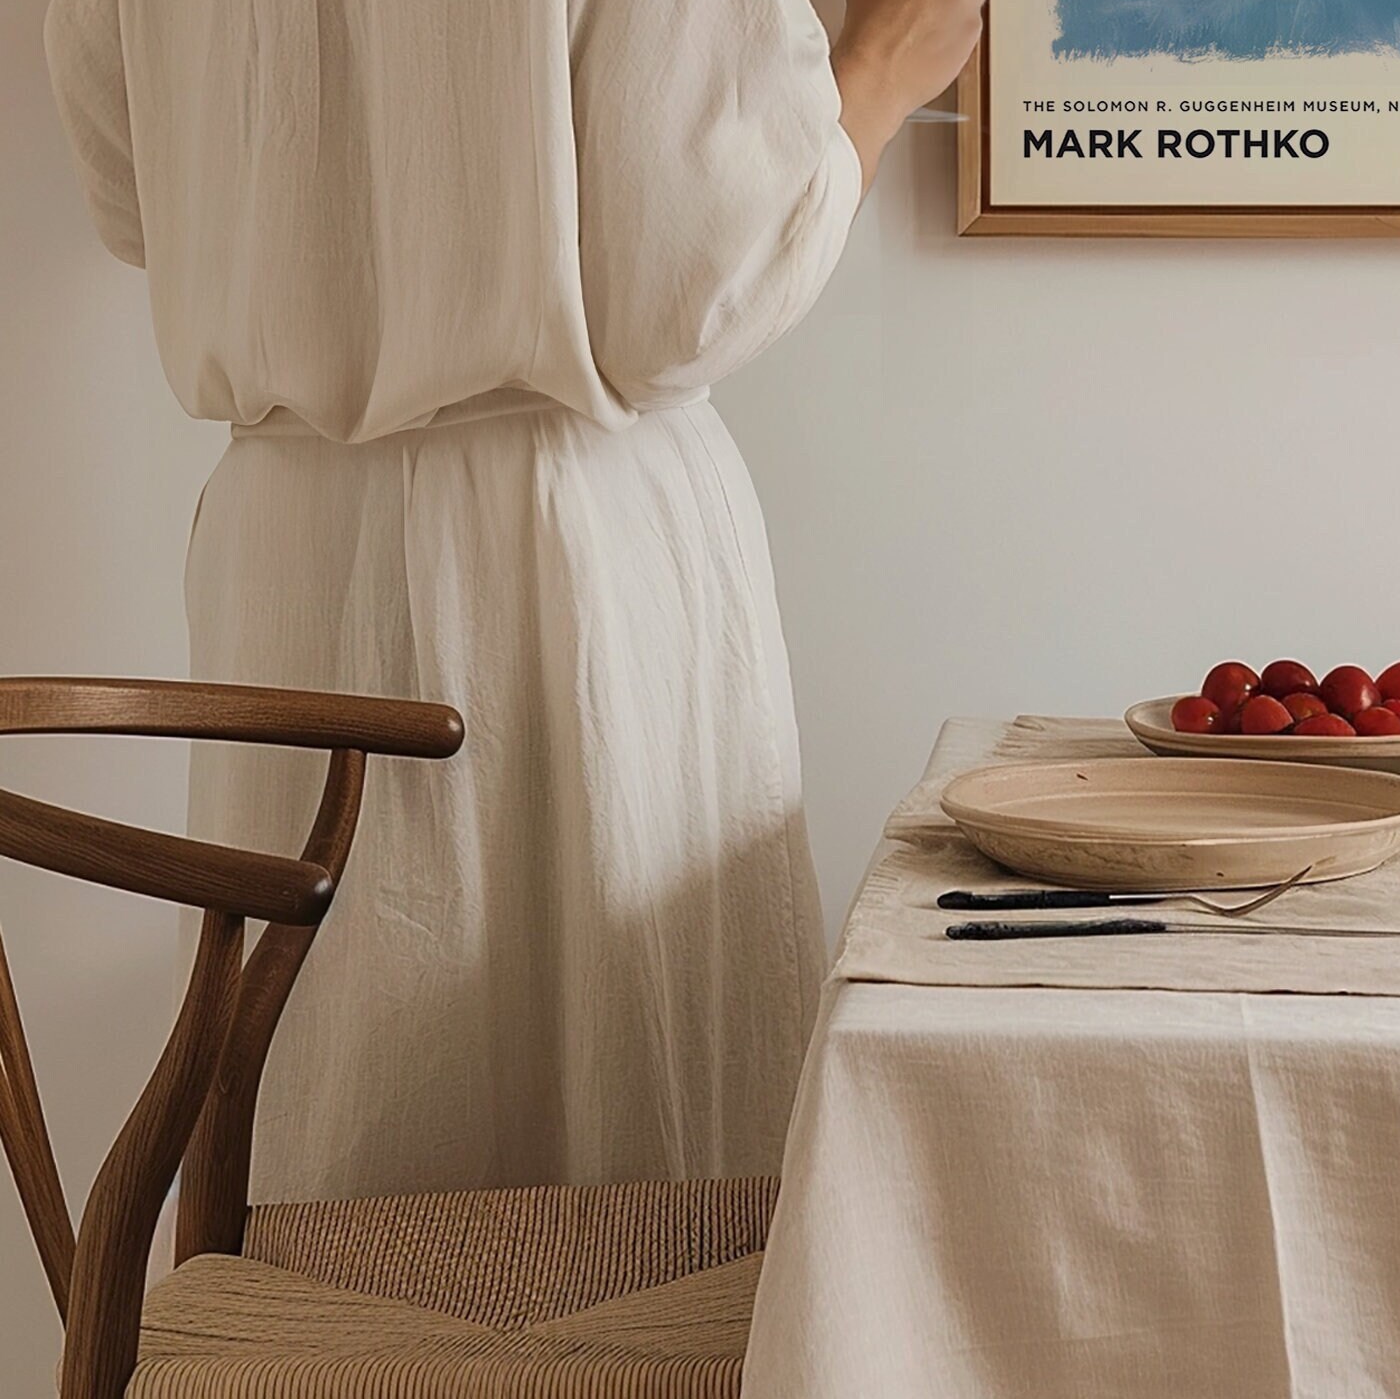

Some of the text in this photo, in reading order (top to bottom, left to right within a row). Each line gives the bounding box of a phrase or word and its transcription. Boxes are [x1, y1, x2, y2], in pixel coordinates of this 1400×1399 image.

[1022, 100, 1056, 112] THE
[1063, 100, 1149, 113] SOLOMON
[1156, 100, 1172, 112] R.
[1179, 100, 1295, 113] GUGGENHEIM
[1303, 100, 1381, 114] MUSEUM,
[1023, 128, 1330, 159] MARK ROTHKO
